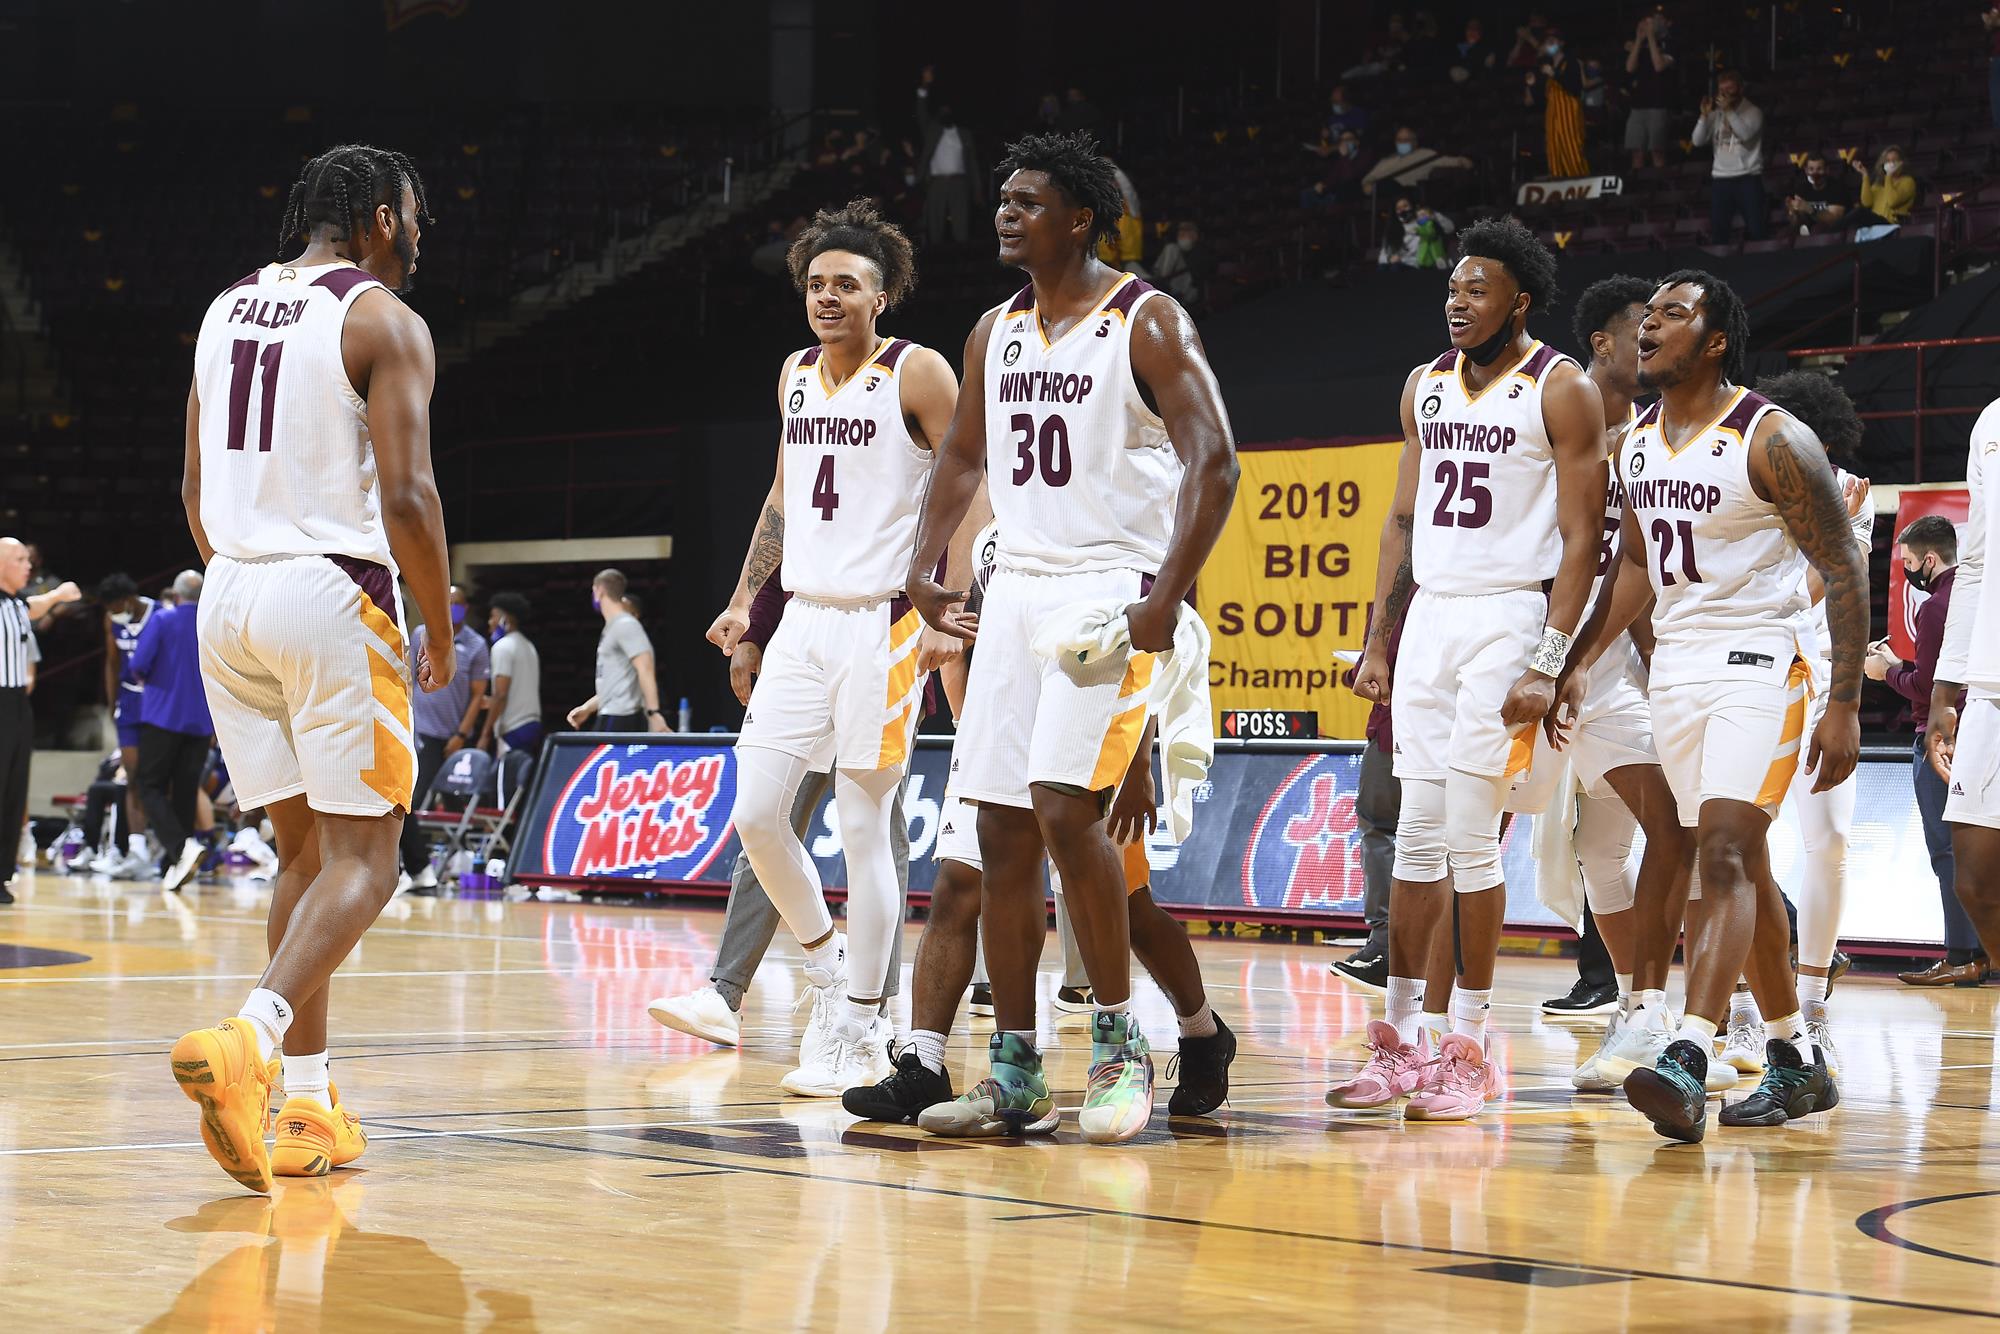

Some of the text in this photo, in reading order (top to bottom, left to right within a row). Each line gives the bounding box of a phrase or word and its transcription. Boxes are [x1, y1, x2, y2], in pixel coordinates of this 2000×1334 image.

[227, 298, 309, 329] FALDEN
[226, 338, 285, 452] 11
[786, 417, 877, 447] WINTHROP
[1010, 413, 1072, 487] 30
[1422, 422, 1516, 454] WINTHROP
[811, 454, 840, 521] 4
[1259, 480, 1361, 520] 2019
[1432, 459, 1493, 529] 25
[1628, 479, 1721, 513] WINTHROP
[1264, 542, 1350, 579] BIG
[1651, 518, 1703, 586] 21
[1217, 601, 1373, 638] SOUT
[1236, 711, 1291, 737] POSS.
[574, 753, 726, 824] Jersey
